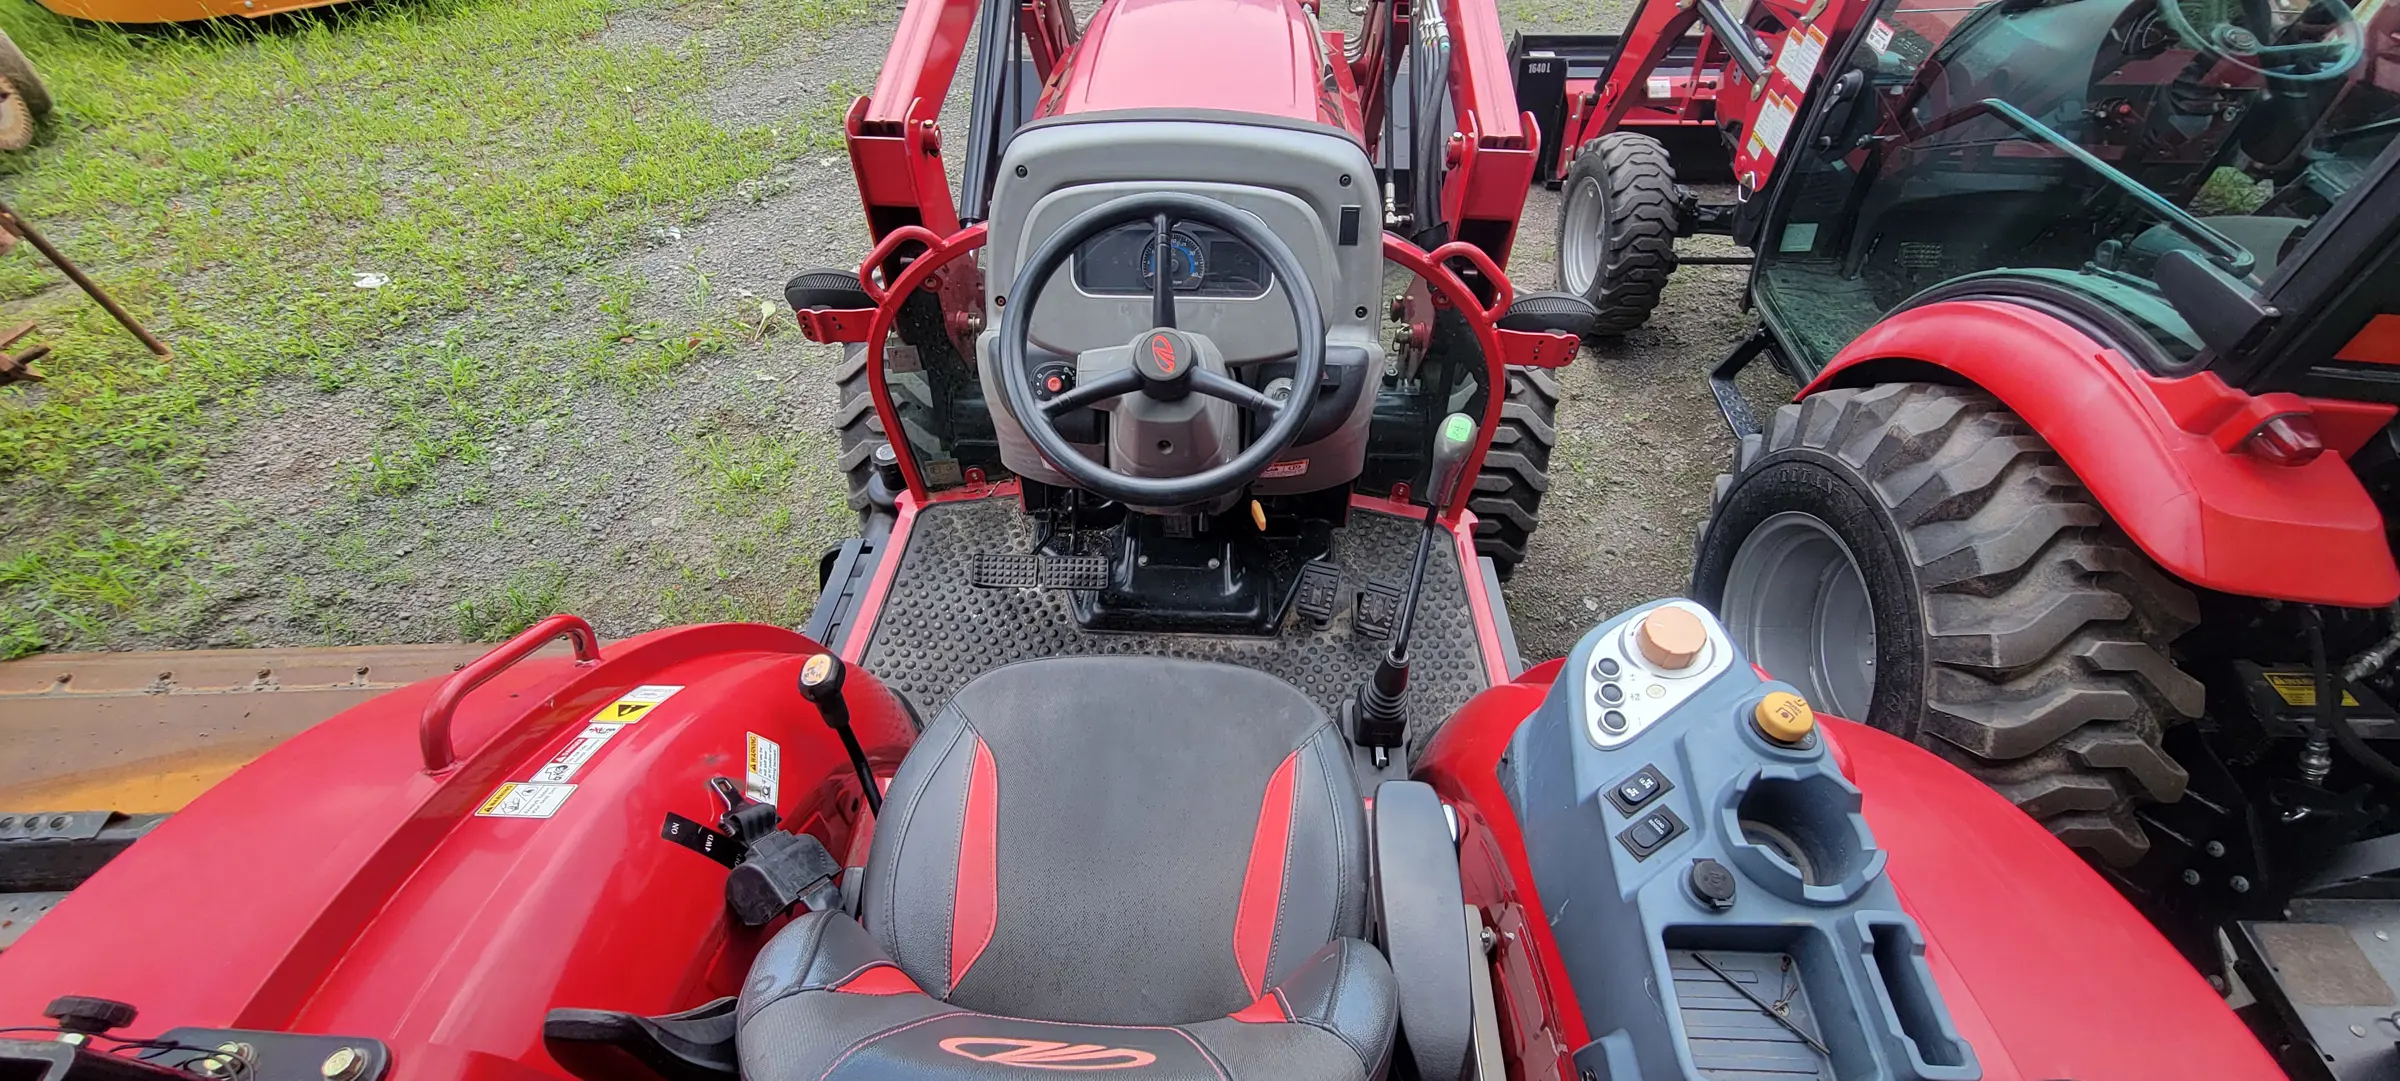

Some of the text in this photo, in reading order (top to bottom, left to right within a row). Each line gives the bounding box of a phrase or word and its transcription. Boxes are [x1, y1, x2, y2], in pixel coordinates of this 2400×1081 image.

[1528, 62, 1546, 74] 1640
[670, 822, 680, 835] ON
[1654, 818, 1665, 829] LOAD
[704, 834, 714, 852] 4WD
